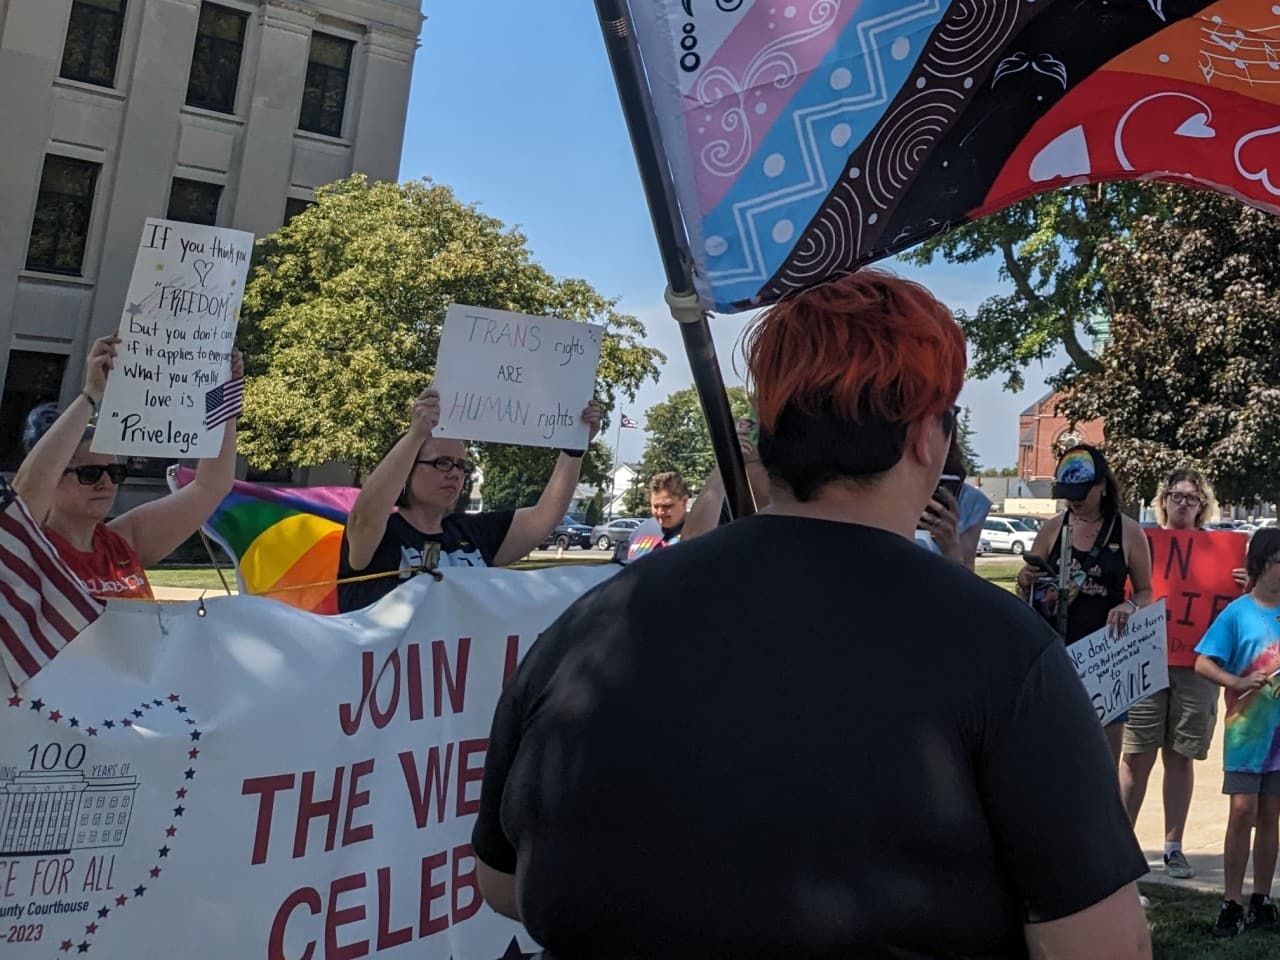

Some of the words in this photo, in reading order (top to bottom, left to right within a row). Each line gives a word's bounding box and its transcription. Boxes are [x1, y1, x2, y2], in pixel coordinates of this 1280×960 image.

[142, 224, 173, 250] If
[180, 237, 205, 262] you
[209, 236, 235, 263] think
[129, 316, 160, 337] but
[166, 328, 186, 344] you
[193, 325, 218, 340] don't
[464, 315, 542, 352] TRANS
[554, 336, 585, 366] rights
[127, 340, 141, 355] if
[145, 344, 155, 357] it
[157, 347, 194, 365] applies
[196, 346, 207, 360] to
[169, 372, 188, 388] you
[497, 365, 524, 384] ARE
[145, 389, 172, 407] love
[180, 392, 194, 408] is
[449, 391, 531, 426] HUMAN
[537, 402, 575, 439] rights
[1132, 621, 1142, 633] to
[339, 638, 471, 736] JOIN
[1110, 668, 1121, 680] to
[28, 742, 86, 770] 100
[92, 763, 117, 777] YEARS
[120, 762, 131, 776] OF
[241, 758, 375, 865] THE
[30, 858, 75, 897] FOR
[83, 854, 116, 892] ALL
[27, 900, 90, 917] Courthouse
